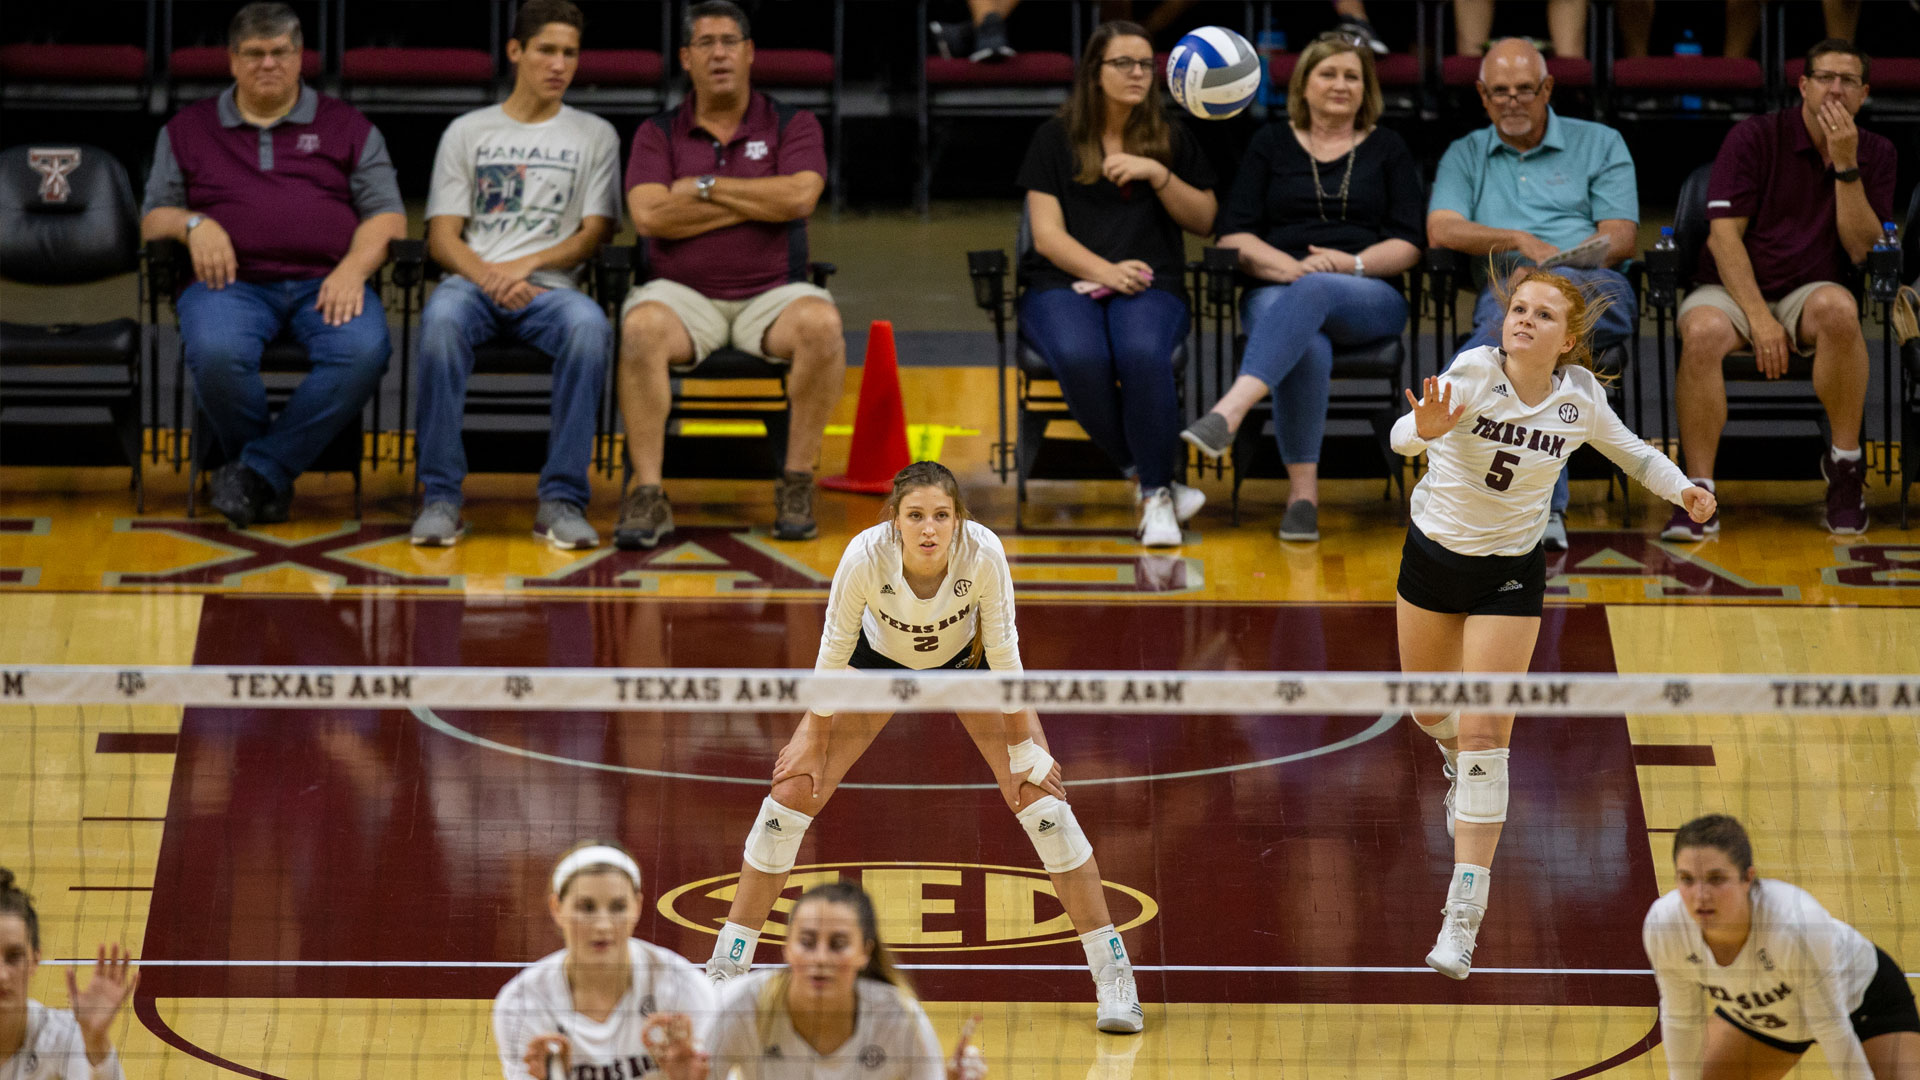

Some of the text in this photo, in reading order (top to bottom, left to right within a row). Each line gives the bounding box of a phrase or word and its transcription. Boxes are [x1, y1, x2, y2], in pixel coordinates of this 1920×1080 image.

[476, 146, 581, 164] HANALEI
[1559, 404, 1578, 423] SEC
[1471, 415, 1566, 458] TEXAS A&M
[1485, 450, 1521, 492] 5
[879, 604, 970, 633] TEXAS A&M
[913, 635, 939, 652] 2
[227, 674, 412, 699] TEXAS A&M
[614, 677, 798, 702] TEXAS A&M
[1000, 679, 1184, 704] TEXAS A&M
[1387, 681, 1569, 706] TEXAS A&M
[1772, 681, 1879, 708] TEXAS
